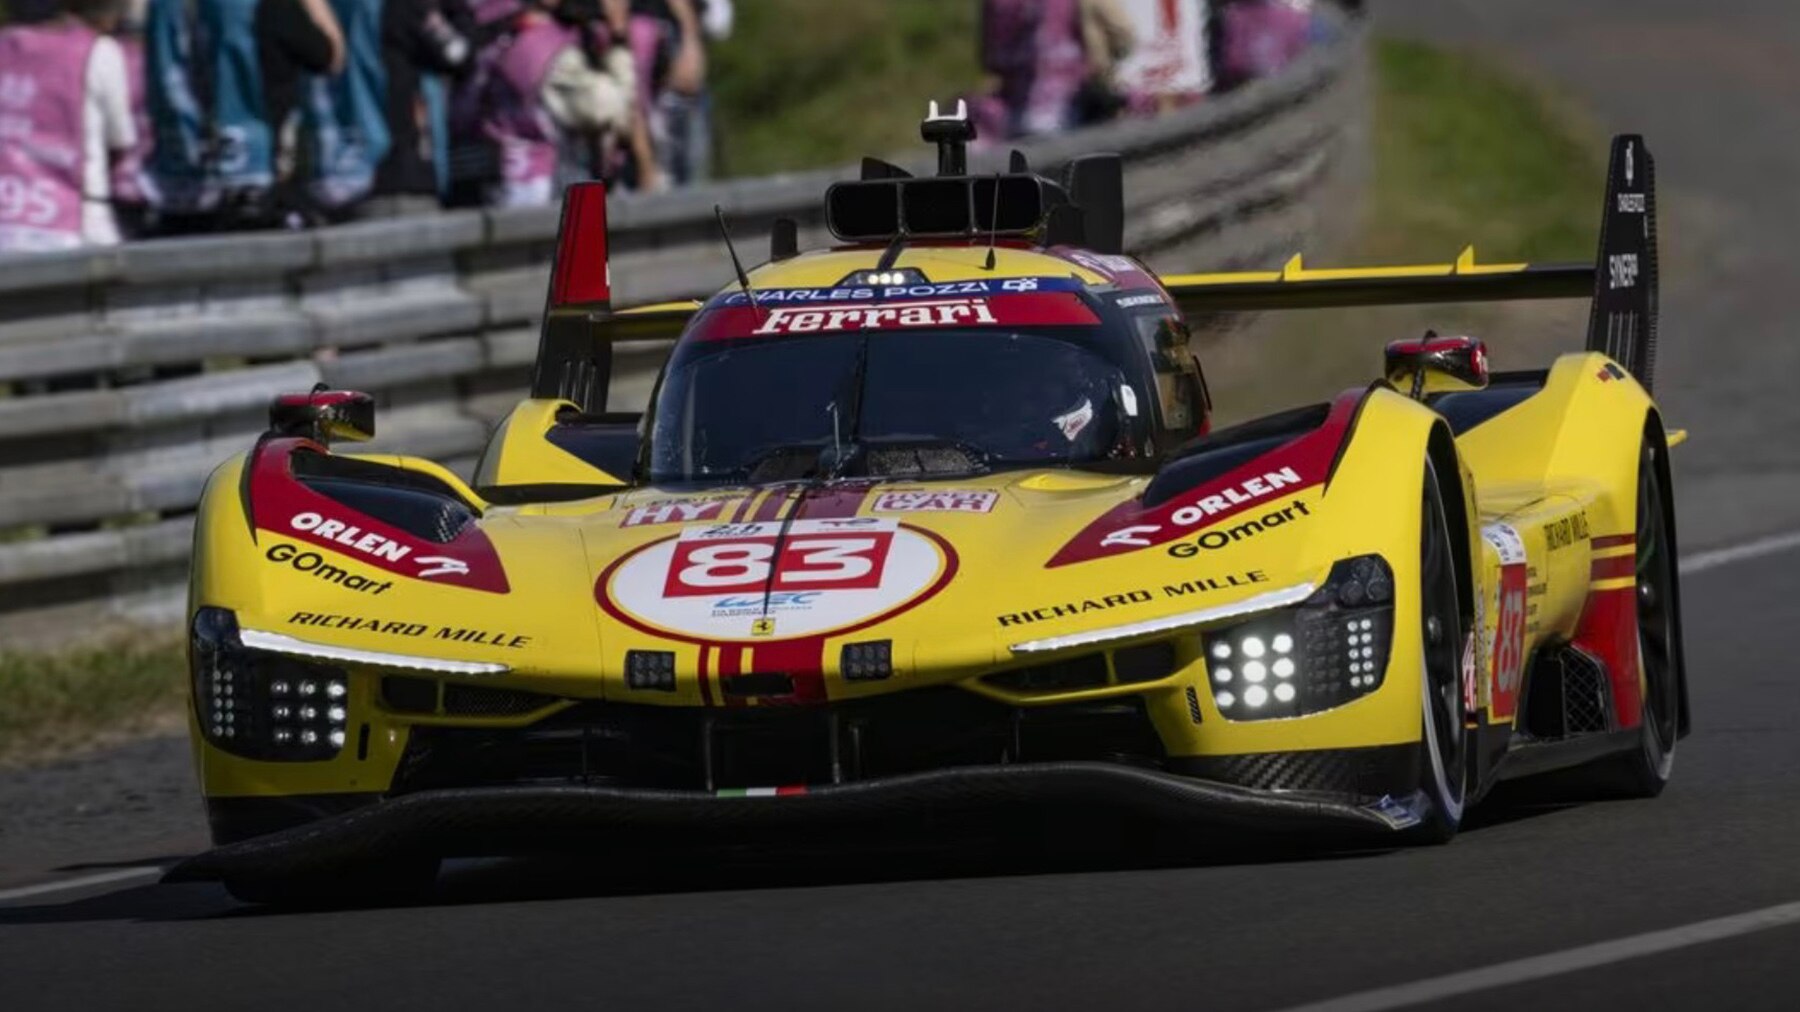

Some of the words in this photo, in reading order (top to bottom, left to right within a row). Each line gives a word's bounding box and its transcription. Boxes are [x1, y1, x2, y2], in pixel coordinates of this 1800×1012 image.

[725, 288, 874, 304] CHARLES
[884, 281, 990, 297] POZZI
[752, 299, 998, 335] Ferrari
[881, 498, 985, 510] CAR
[1171, 466, 1302, 526] ORLEN
[291, 512, 412, 562] ORLEN
[1167, 500, 1311, 558] GOmart
[265, 543, 393, 594] GOmart
[678, 538, 876, 588] 83
[997, 589, 1153, 627] RICHARD
[1162, 570, 1270, 598] MILLE
[288, 612, 428, 637] RICHARD
[434, 627, 533, 648] MILLE
